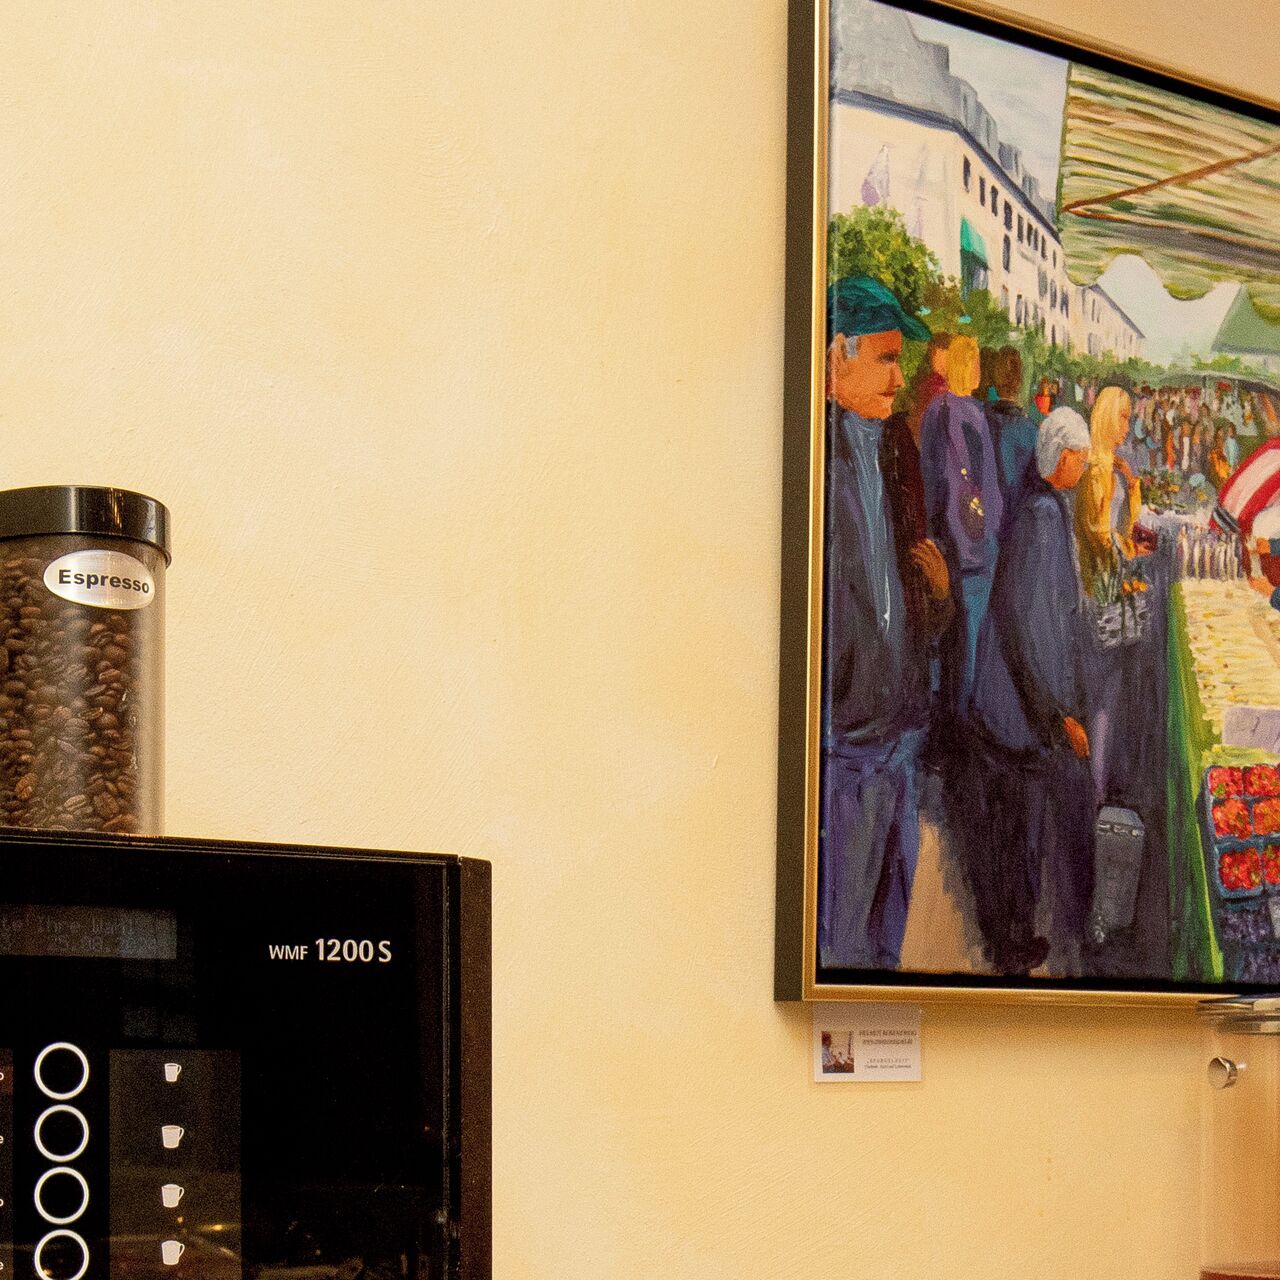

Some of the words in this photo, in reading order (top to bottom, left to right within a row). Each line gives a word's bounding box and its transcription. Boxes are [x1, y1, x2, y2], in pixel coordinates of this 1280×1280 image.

[58, 569, 150, 593] Espresso
[268, 944, 309, 961] WMF
[315, 938, 375, 962] 1200
[378, 940, 393, 963] S
